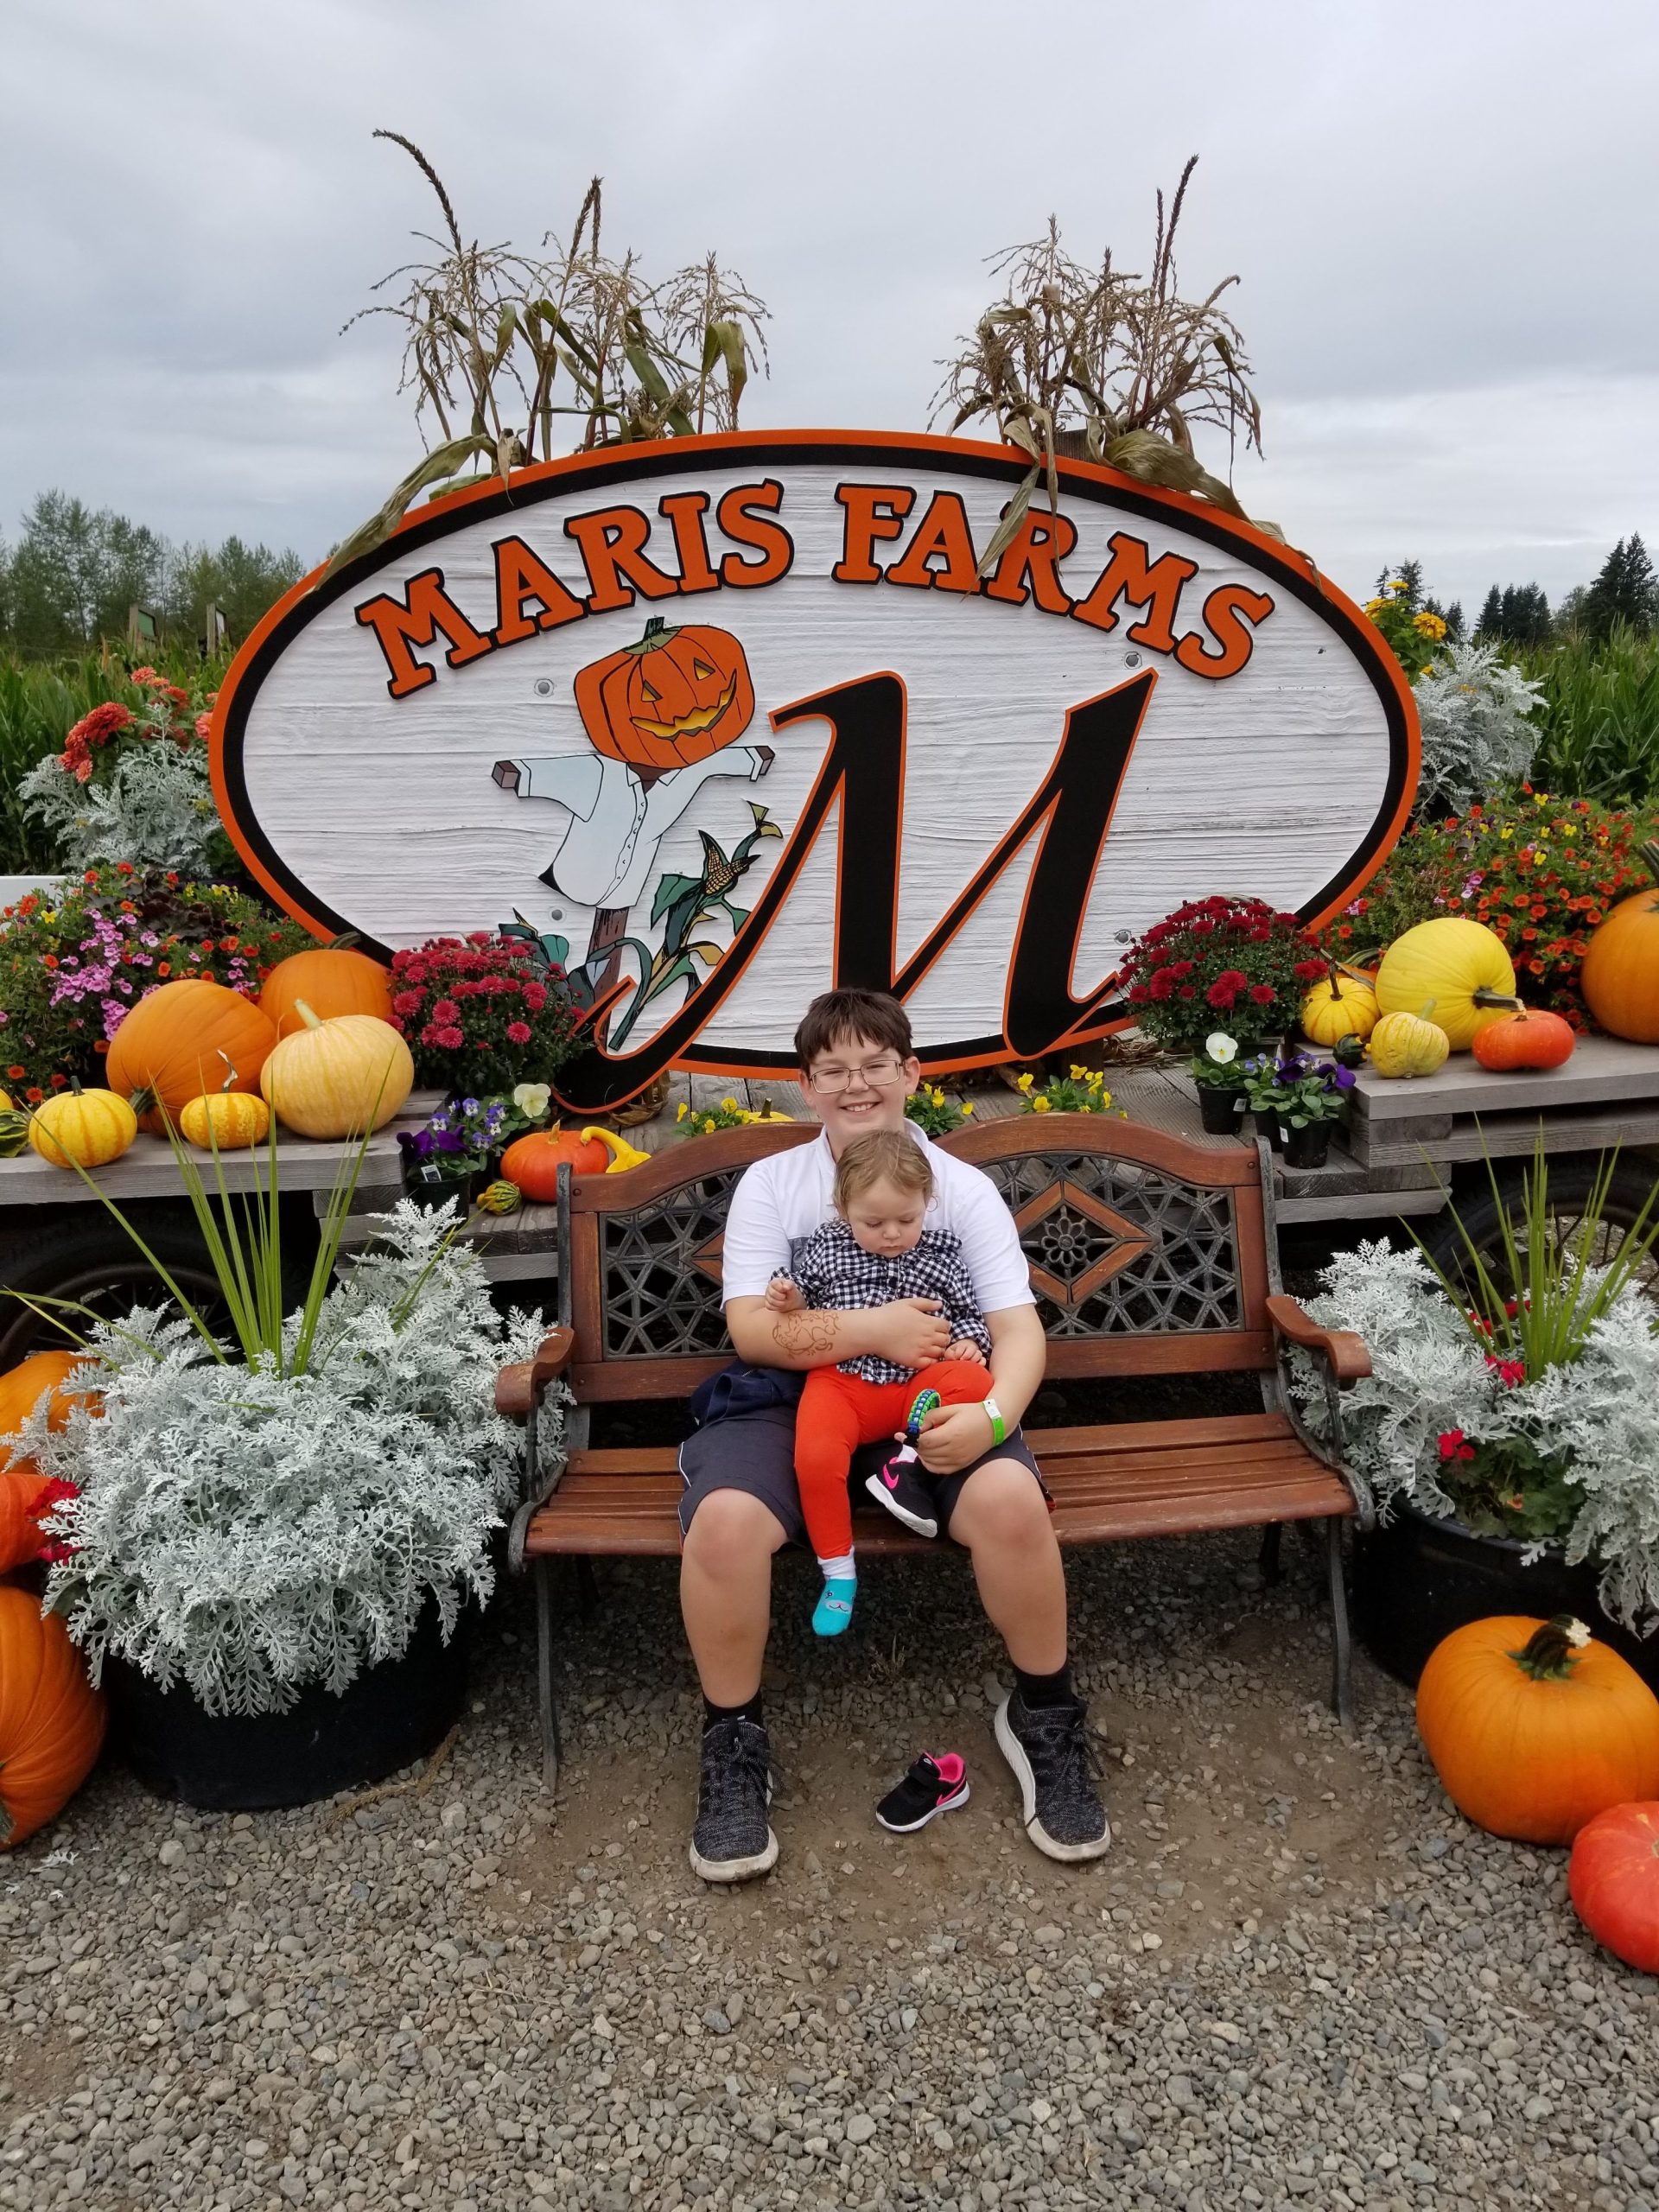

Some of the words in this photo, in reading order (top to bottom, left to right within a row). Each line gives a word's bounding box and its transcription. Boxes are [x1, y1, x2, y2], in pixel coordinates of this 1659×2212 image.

[354, 478, 795, 699] MARIS
[830, 483, 1275, 680] FARMS
[554, 667, 1159, 1114] M
